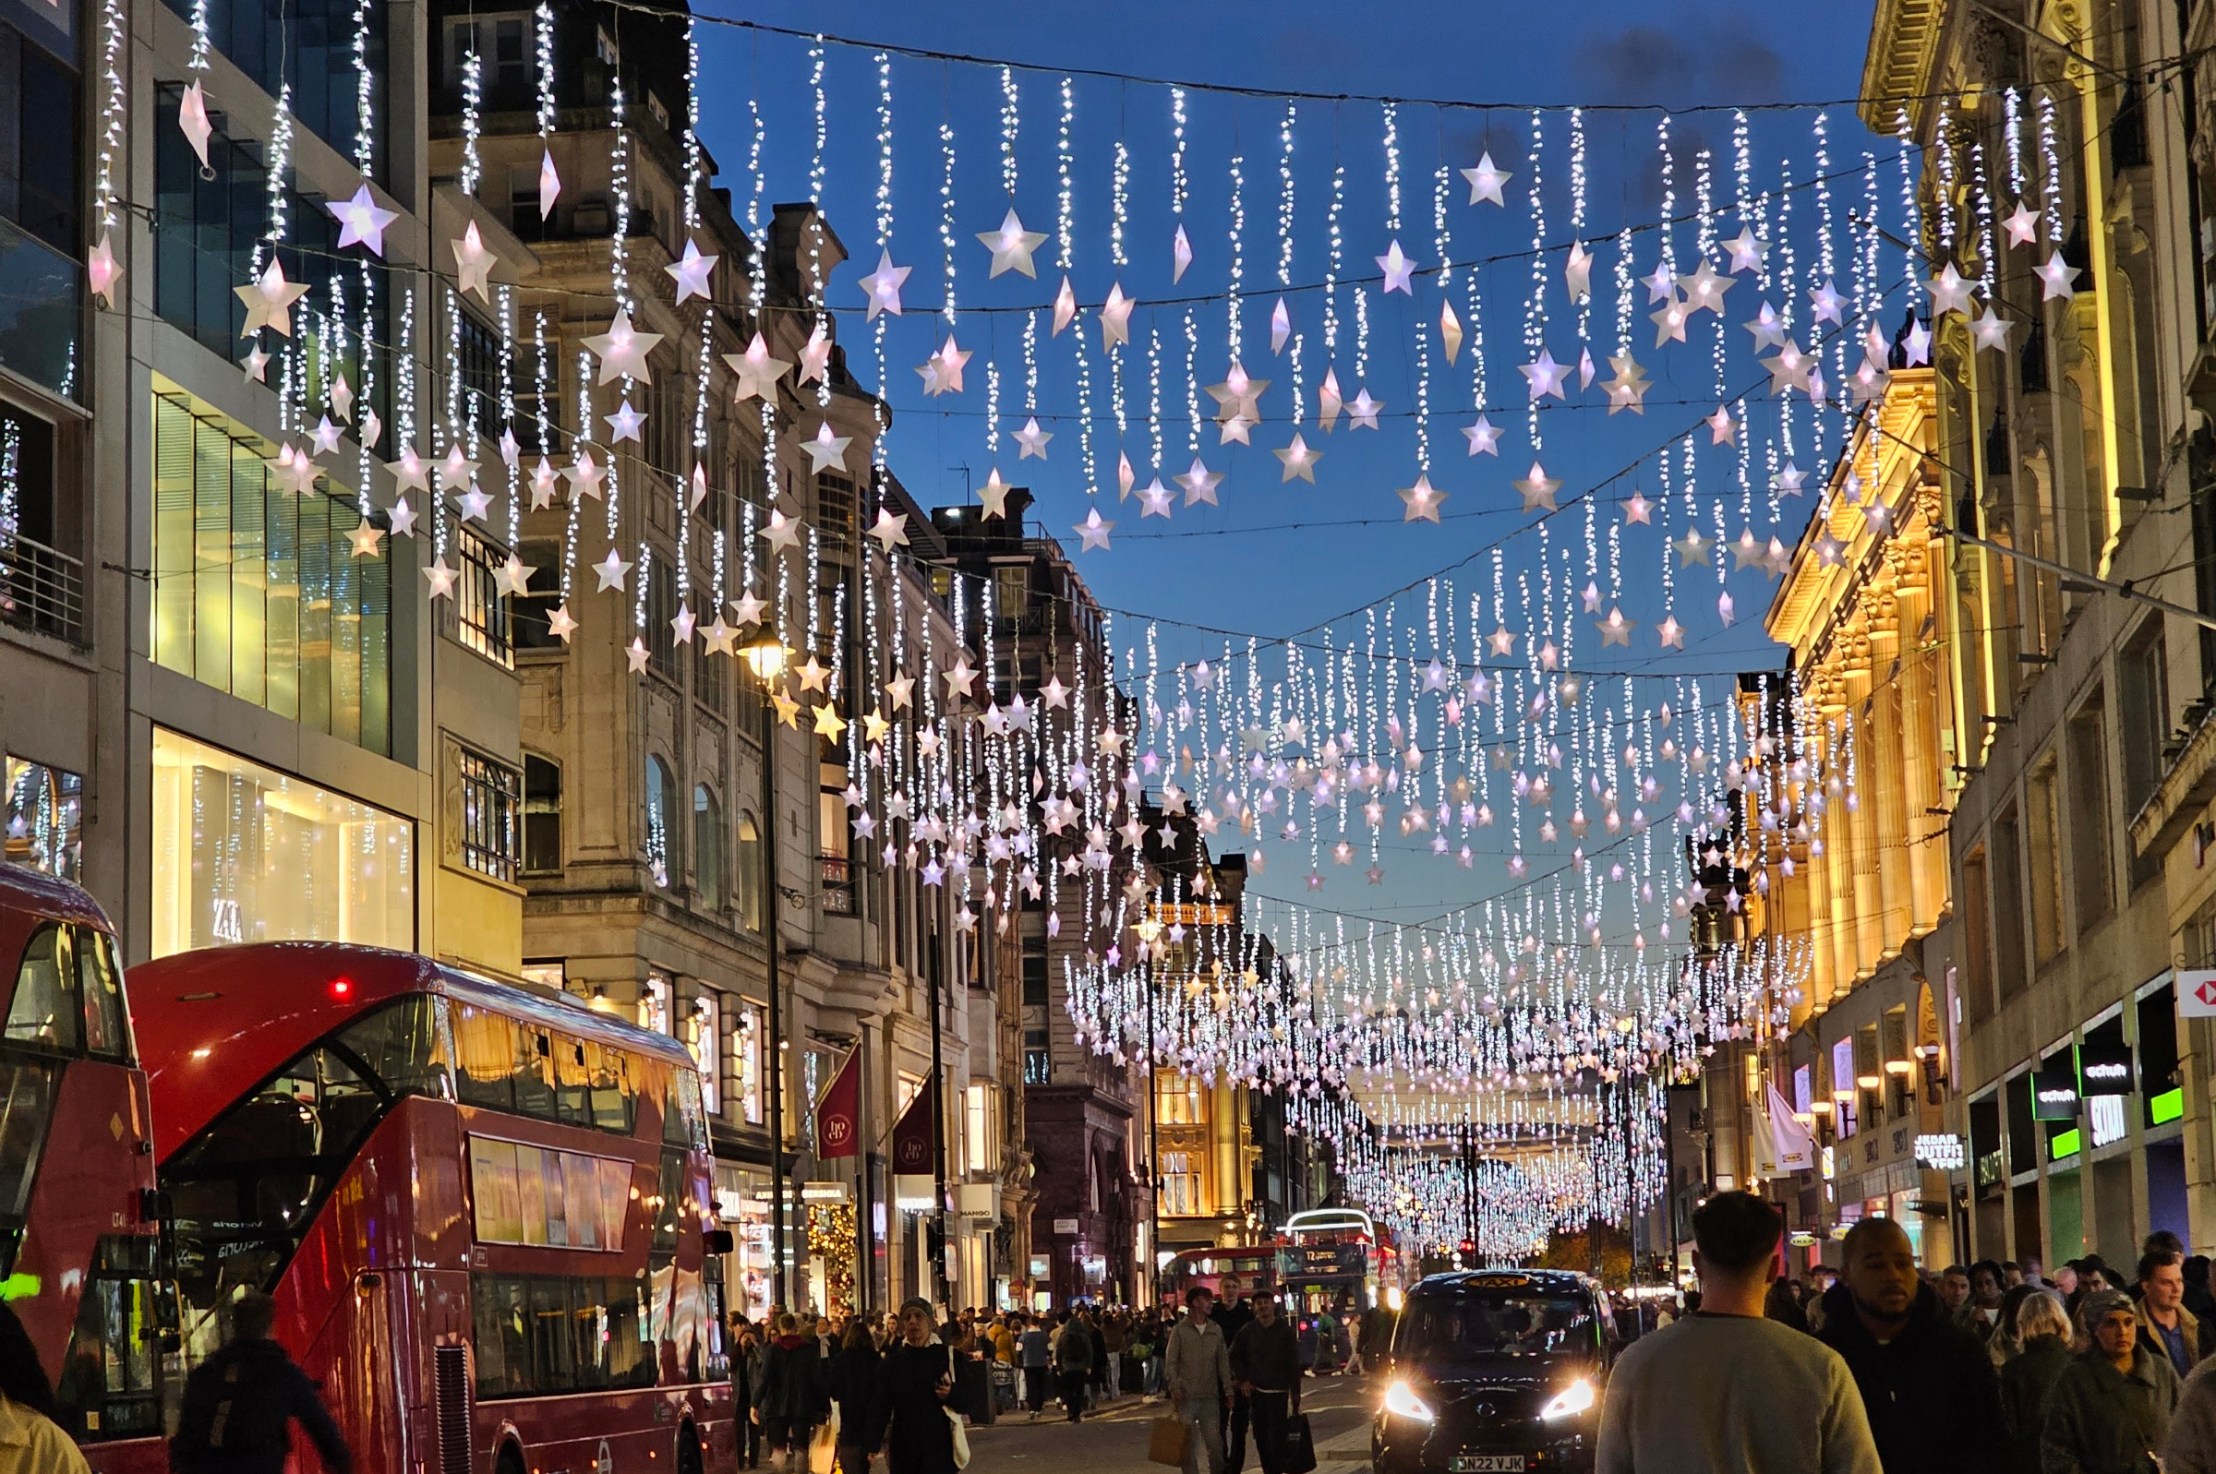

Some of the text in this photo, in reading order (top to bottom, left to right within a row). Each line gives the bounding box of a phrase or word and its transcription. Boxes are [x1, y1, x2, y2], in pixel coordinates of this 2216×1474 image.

[2085, 1063, 2127, 1078] schuh
[2038, 1089, 2076, 1103] schuh
[1474, 1278, 1519, 1288] TAXI
[1496, 1457, 1522, 1471] VJK
